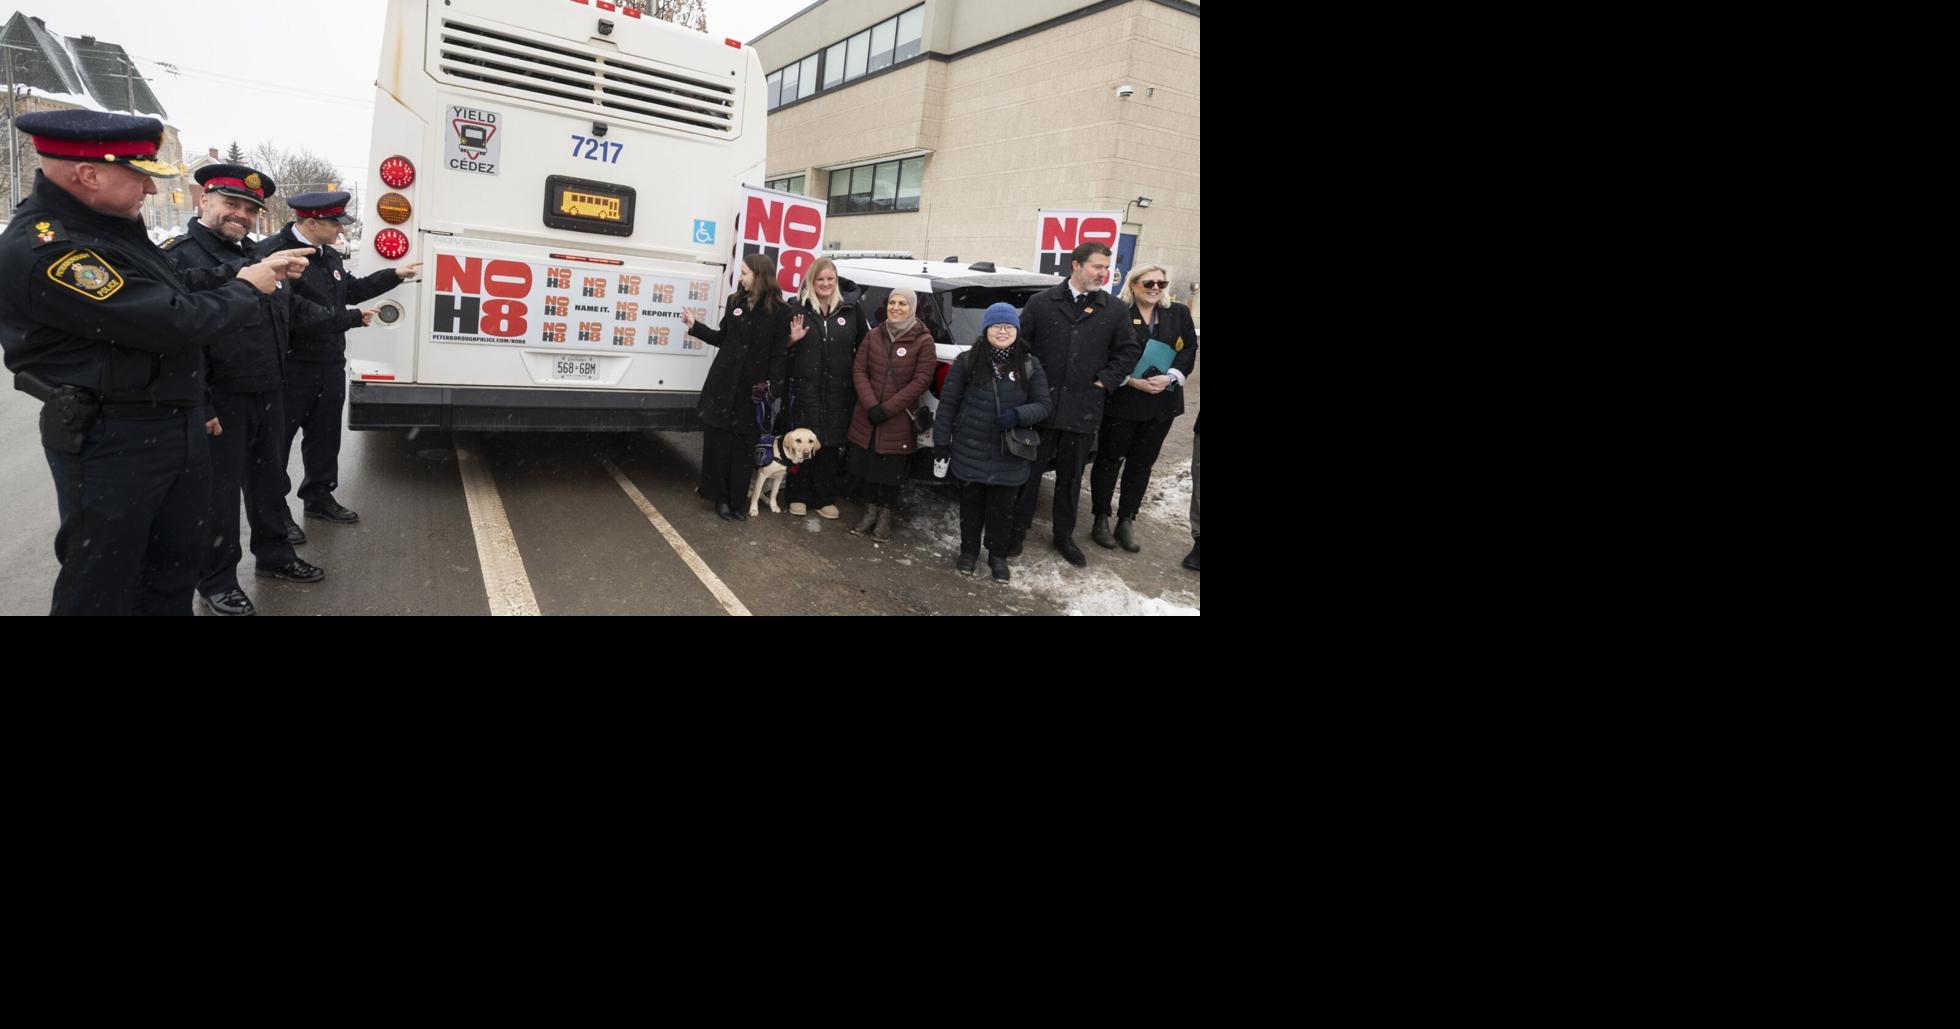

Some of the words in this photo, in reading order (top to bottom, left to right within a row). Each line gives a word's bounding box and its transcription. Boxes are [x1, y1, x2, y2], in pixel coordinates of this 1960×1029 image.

[453, 107, 496, 124] YIELD
[571, 135, 623, 164] 7217
[450, 158, 495, 174] CÉDEZ
[744, 196, 822, 250] NO
[1041, 217, 1118, 250] NO
[435, 254, 533, 298] NO
[547, 267, 572, 278] NO
[547, 278, 571, 289] H8
[583, 277, 607, 288] NO
[619, 274, 641, 286] NO
[96, 280, 120, 296] POLICE
[583, 287, 606, 298] H8
[618, 284, 640, 295] H8
[653, 284, 674, 294] NO
[545, 296, 569, 306] NO
[544, 305, 568, 317] H8
[575, 304, 598, 312] NAME
[616, 302, 639, 312] NO
[433, 294, 528, 338] H8
[616, 310, 637, 321] H8
[642, 309, 672, 318] REPORT
[543, 322, 567, 333] NO
[579, 322, 602, 332] NO
[614, 326, 636, 337] NO
[649, 326, 670, 336] NO
[542, 332, 566, 342] H8
[578, 331, 601, 342] H8
[613, 336, 635, 346] H8
[558, 362, 574, 374] 568
